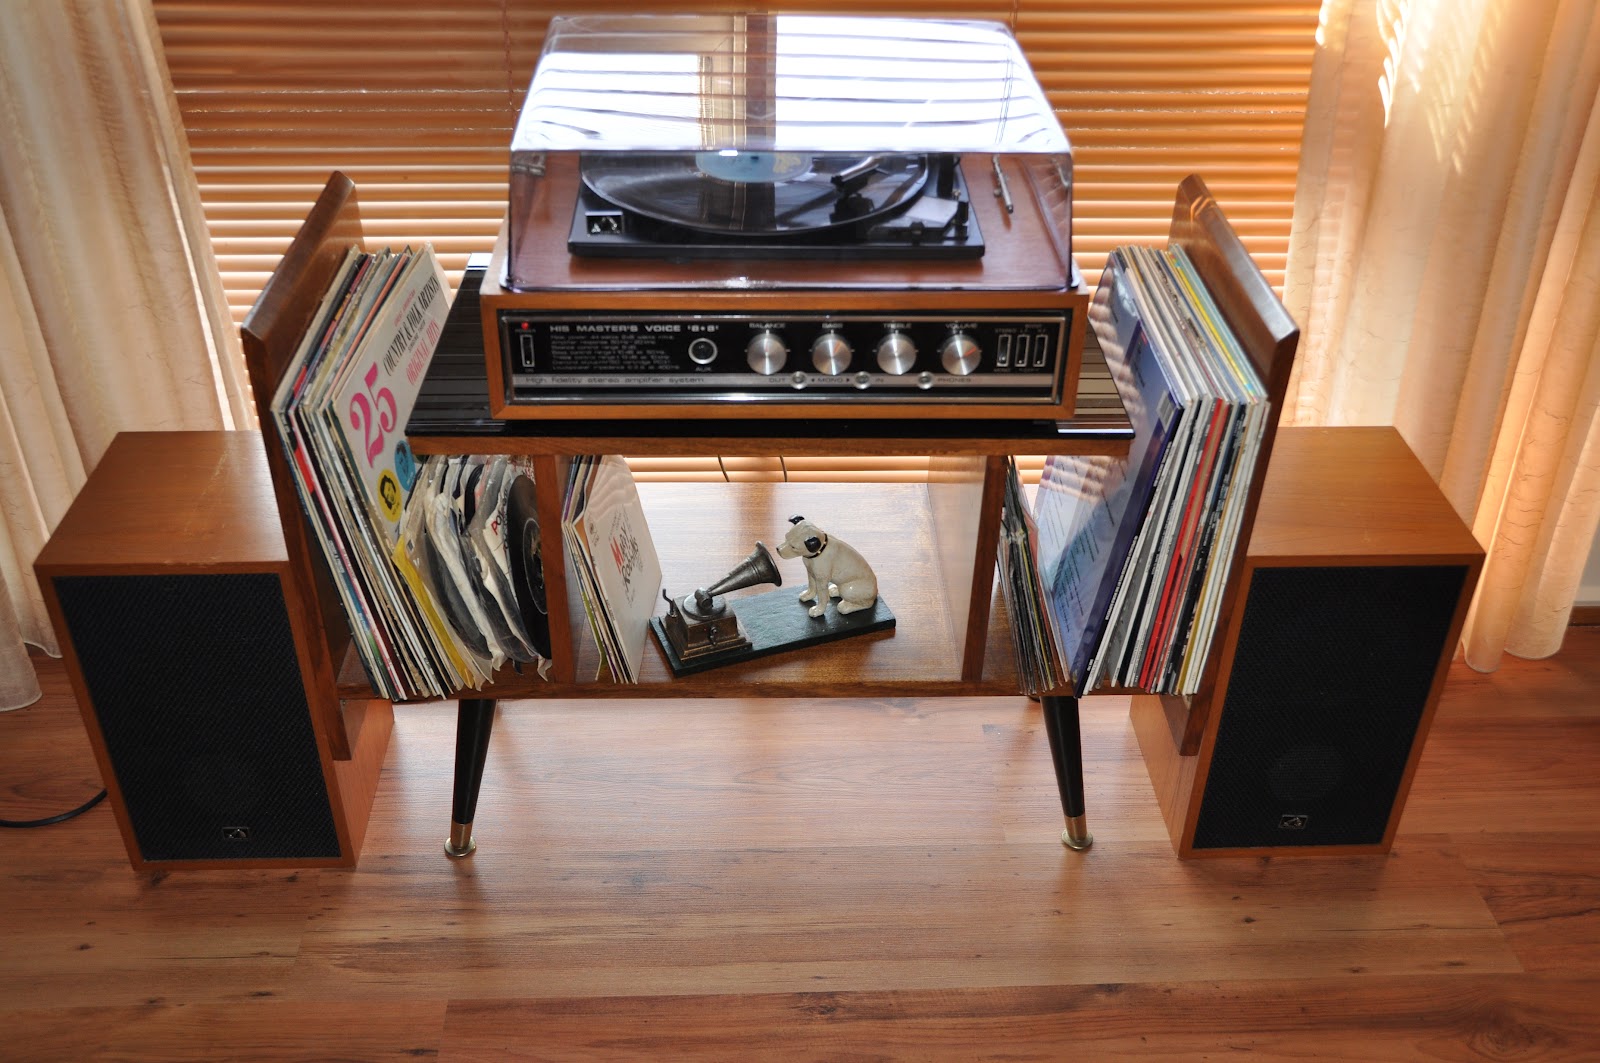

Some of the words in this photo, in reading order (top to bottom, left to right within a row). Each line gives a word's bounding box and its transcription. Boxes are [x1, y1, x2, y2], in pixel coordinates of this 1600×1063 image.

[383, 327, 408, 376] COUNTRY
[406, 303, 423, 334] FOLK
[550, 325, 570, 333] HIS
[576, 325, 639, 333] MASTER'S
[645, 325, 681, 333] VOICE
[406, 338, 430, 386] ORIGINAL
[526, 377, 546, 385] High
[552, 377, 581, 385] fidelity
[624, 376, 663, 385] amplifier
[669, 377, 704, 385] system
[350, 361, 397, 469] 25
